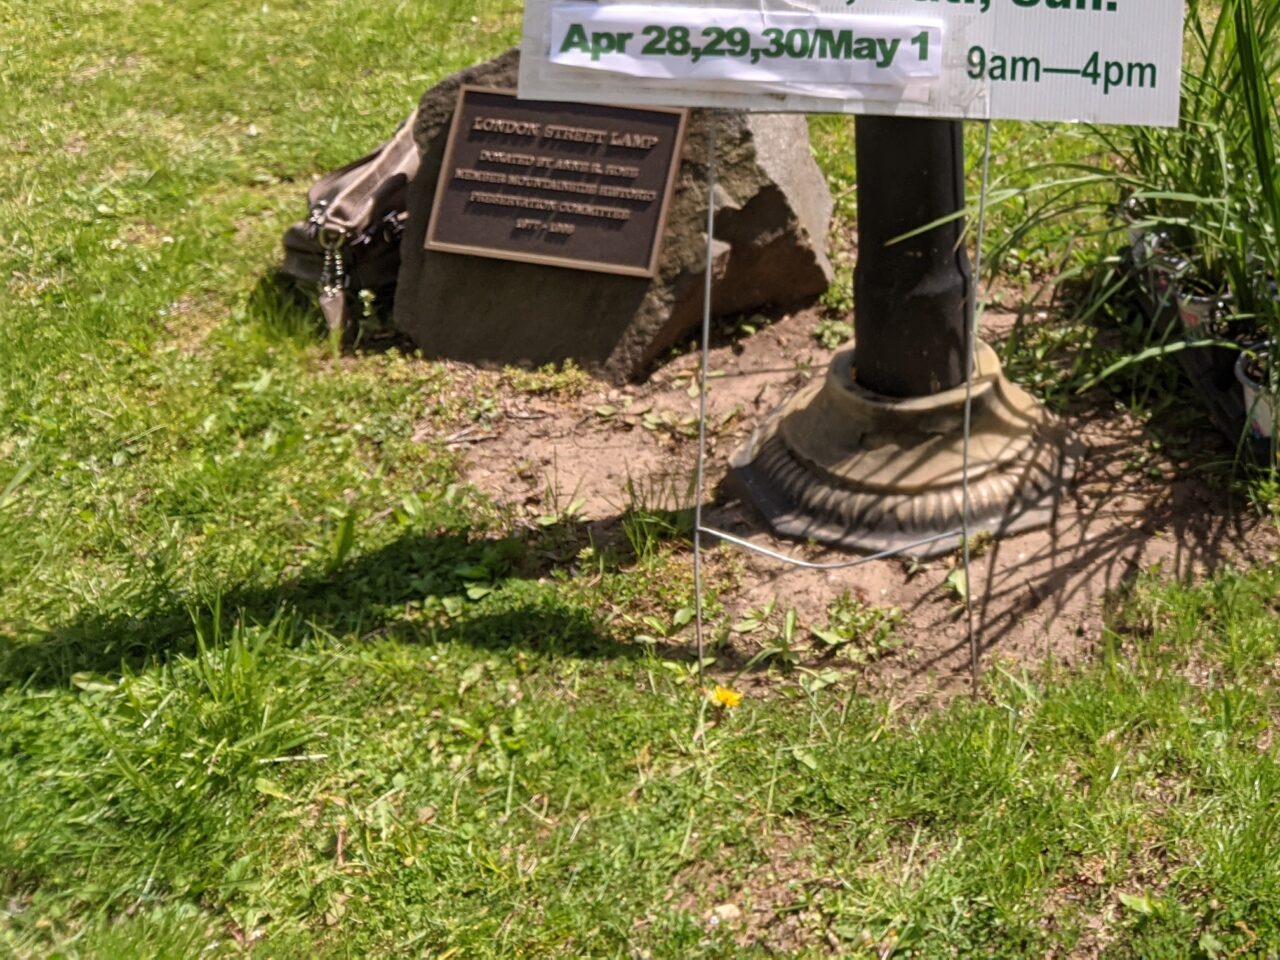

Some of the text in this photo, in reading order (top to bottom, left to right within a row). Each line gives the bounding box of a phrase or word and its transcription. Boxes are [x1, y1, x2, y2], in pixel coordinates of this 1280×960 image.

[560, 24, 633, 60] Apr
[911, 31, 930, 61] 1
[472, 116, 659, 150] LONDON STREET LAMP
[559, 200, 631, 220] COMMITTEE
